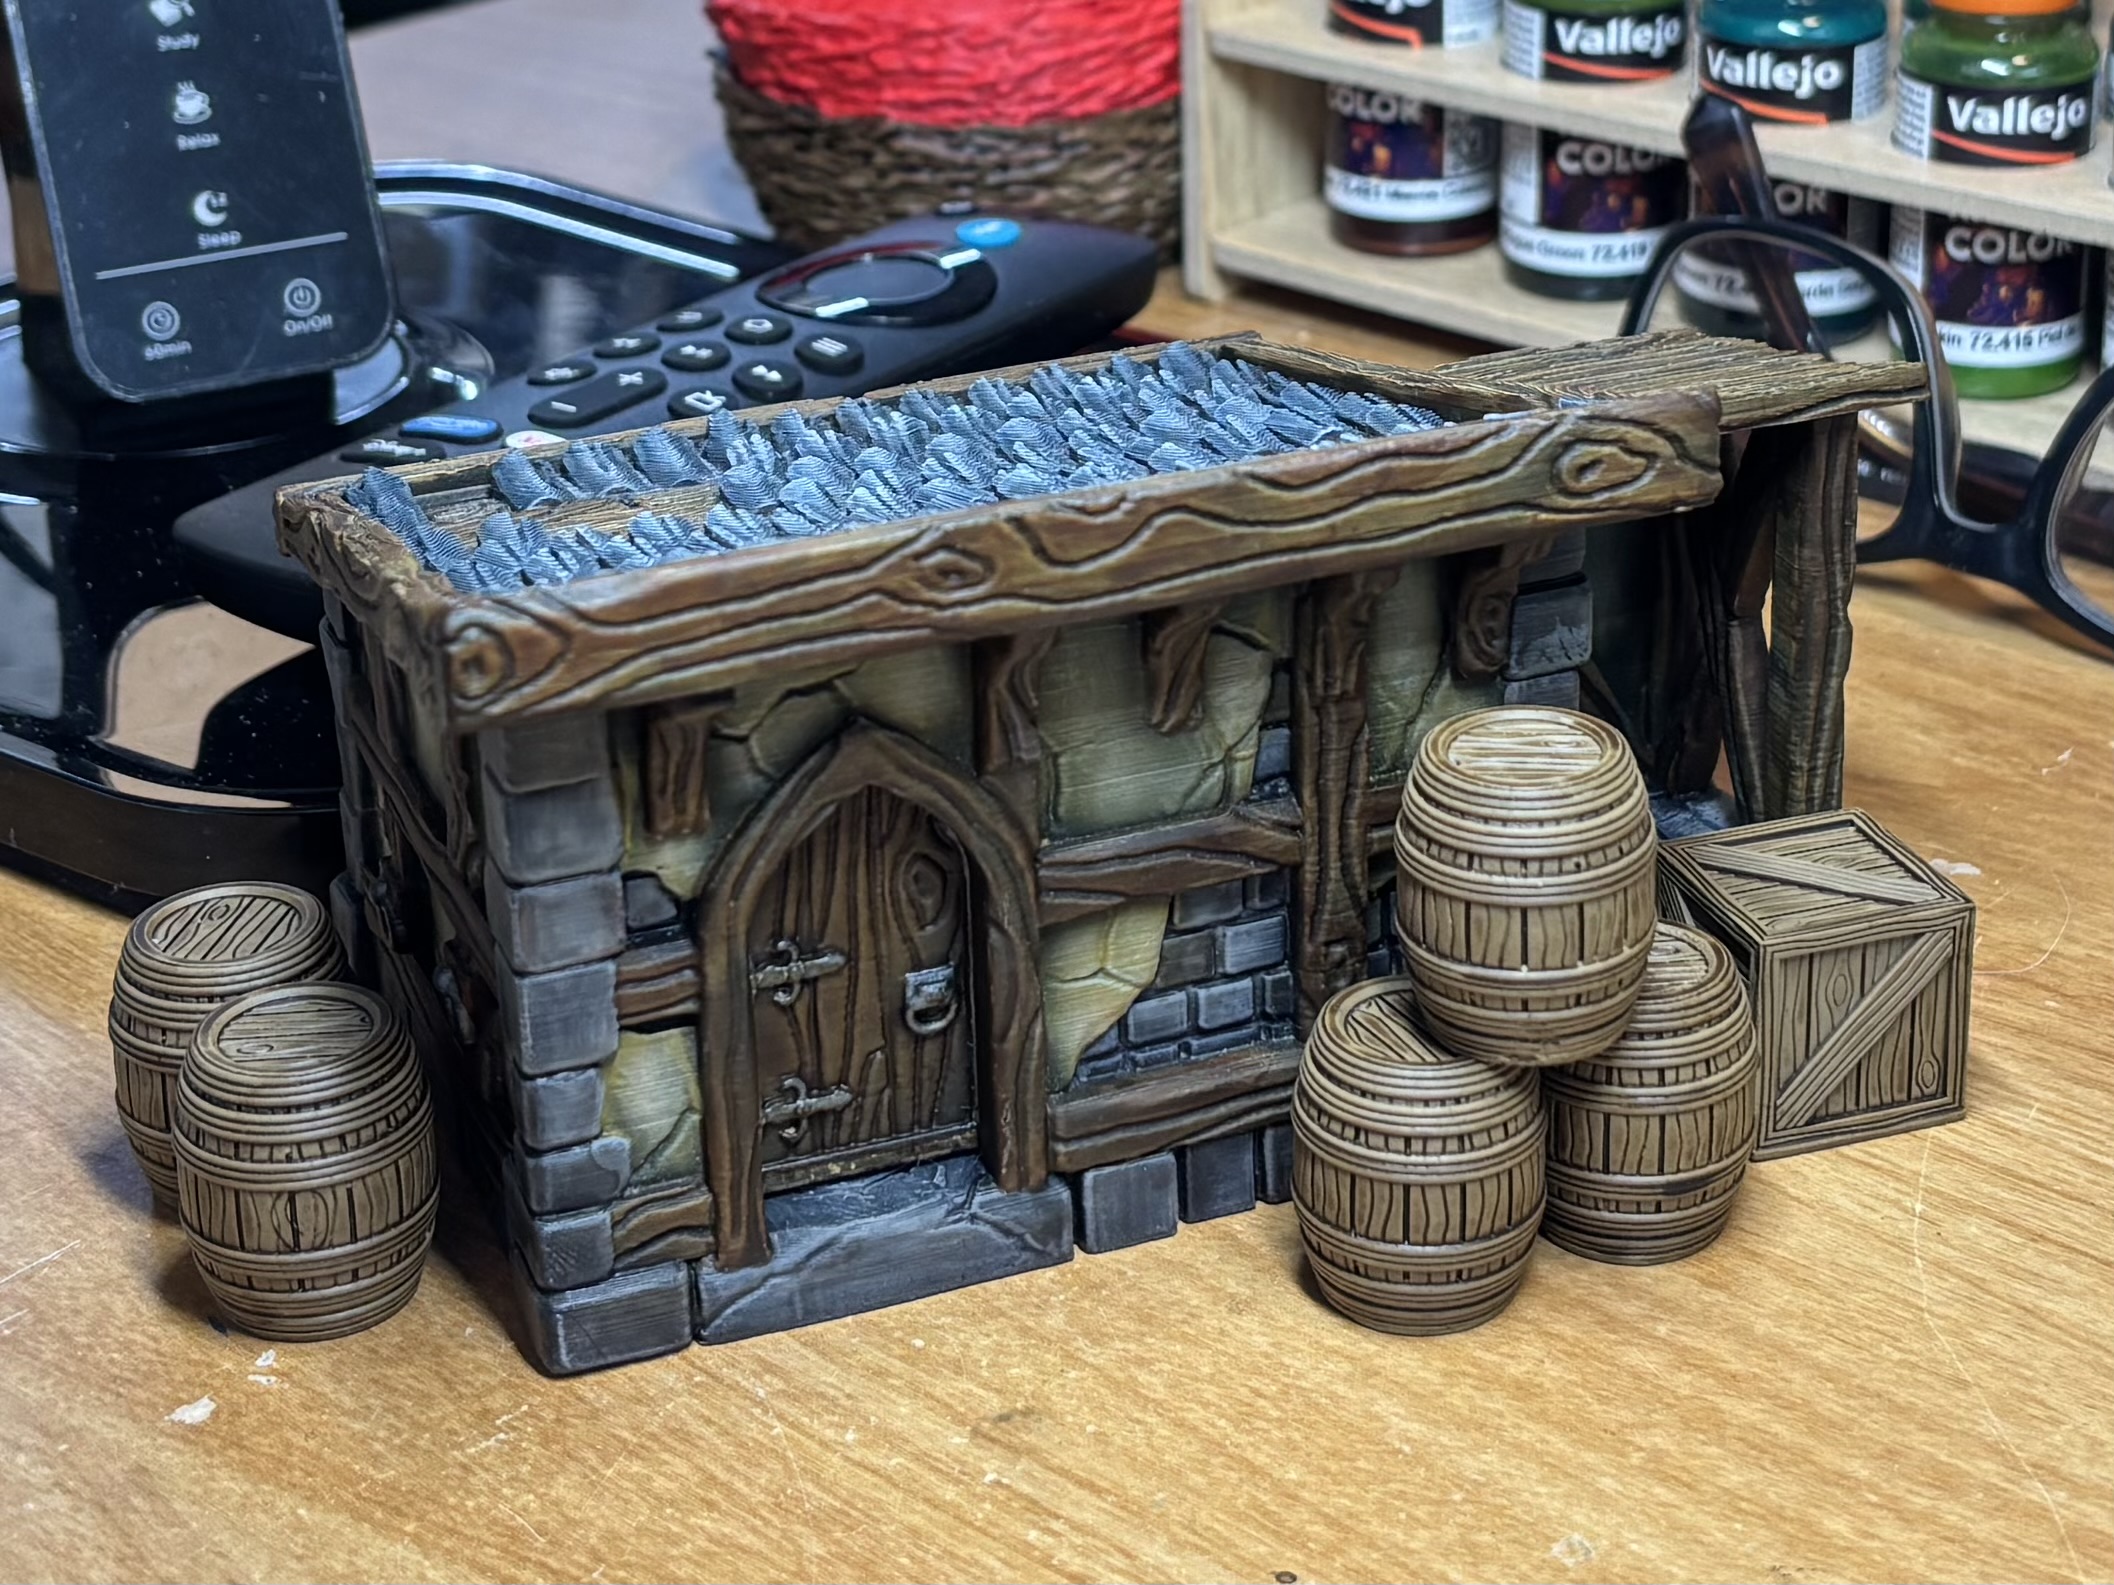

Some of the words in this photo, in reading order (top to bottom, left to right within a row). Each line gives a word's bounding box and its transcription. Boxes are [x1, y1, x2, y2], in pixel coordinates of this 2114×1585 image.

[1554, 14, 1682, 59] Vallejo
[1706, 45, 1842, 100] Vallejo
[1946, 94, 2088, 142] Vallejo
[177, 132, 221, 152] Relax
[1556, 140, 1665, 176] COLO
